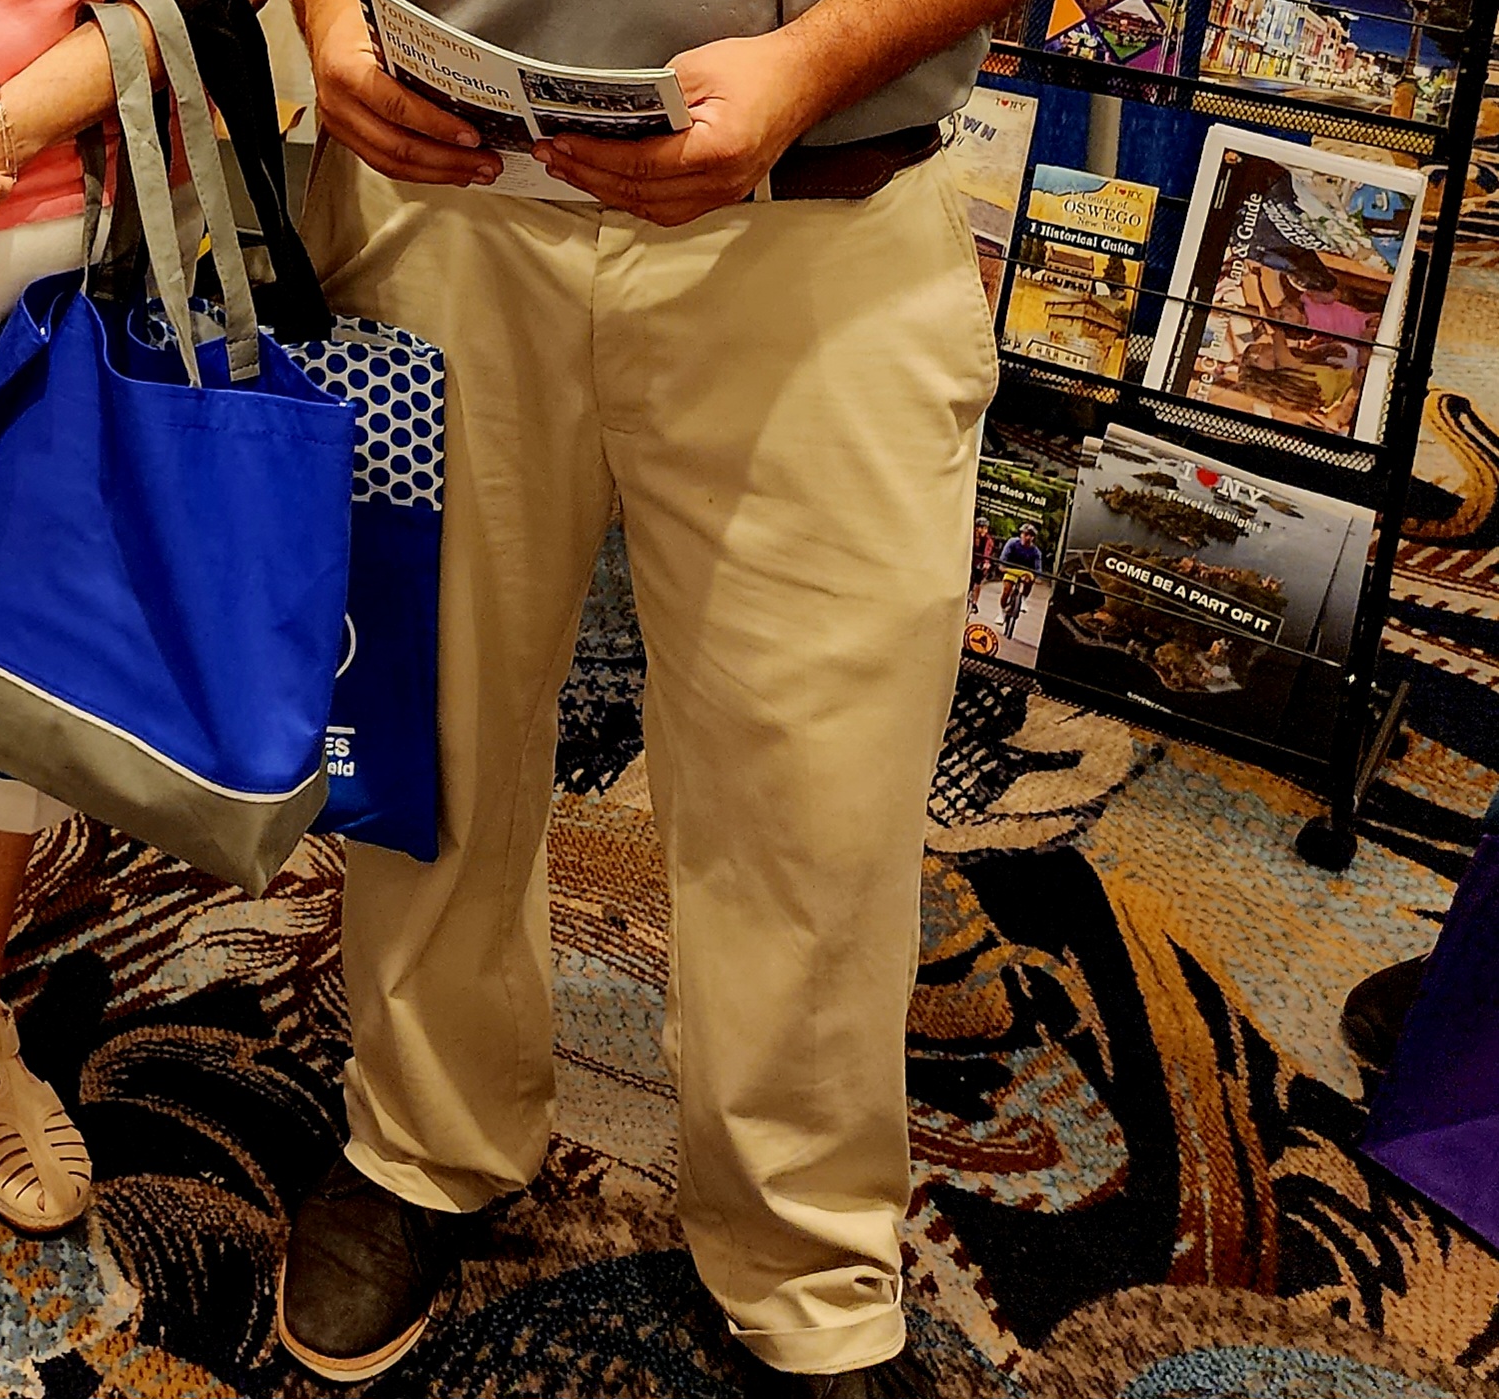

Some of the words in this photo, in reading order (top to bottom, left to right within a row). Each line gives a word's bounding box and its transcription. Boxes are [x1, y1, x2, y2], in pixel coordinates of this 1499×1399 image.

[408, 31, 437, 56] the
[418, 23, 481, 63] Search
[385, 30, 428, 66] Right
[431, 57, 510, 100] Location
[424, 68, 455, 92] Got
[1063, 198, 1142, 228] OSWEGO
[1077, 216, 1099, 228] New
[1100, 221, 1124, 234] York
[1236, 193, 1263, 241] Guide
[1040, 224, 1099, 249] Historical
[1101, 240, 1136, 256] Guide
[1231, 242, 1250, 261] &
[999, 484, 1026, 501] State
[1026, 492, 1048, 508] Trail
[1179, 461, 1196, 482] I
[1217, 475, 1270, 509] NY
[1166, 489, 1203, 510] Travel
[1204, 504, 1264, 534] Highlights
[1105, 557, 1152, 584] COME
[1152, 575, 1175, 593] BE
[1174, 585, 1187, 600] A
[1189, 590, 1230, 616] PART
[1230, 608, 1254, 625] OF
[1254, 617, 1271, 632] IT
